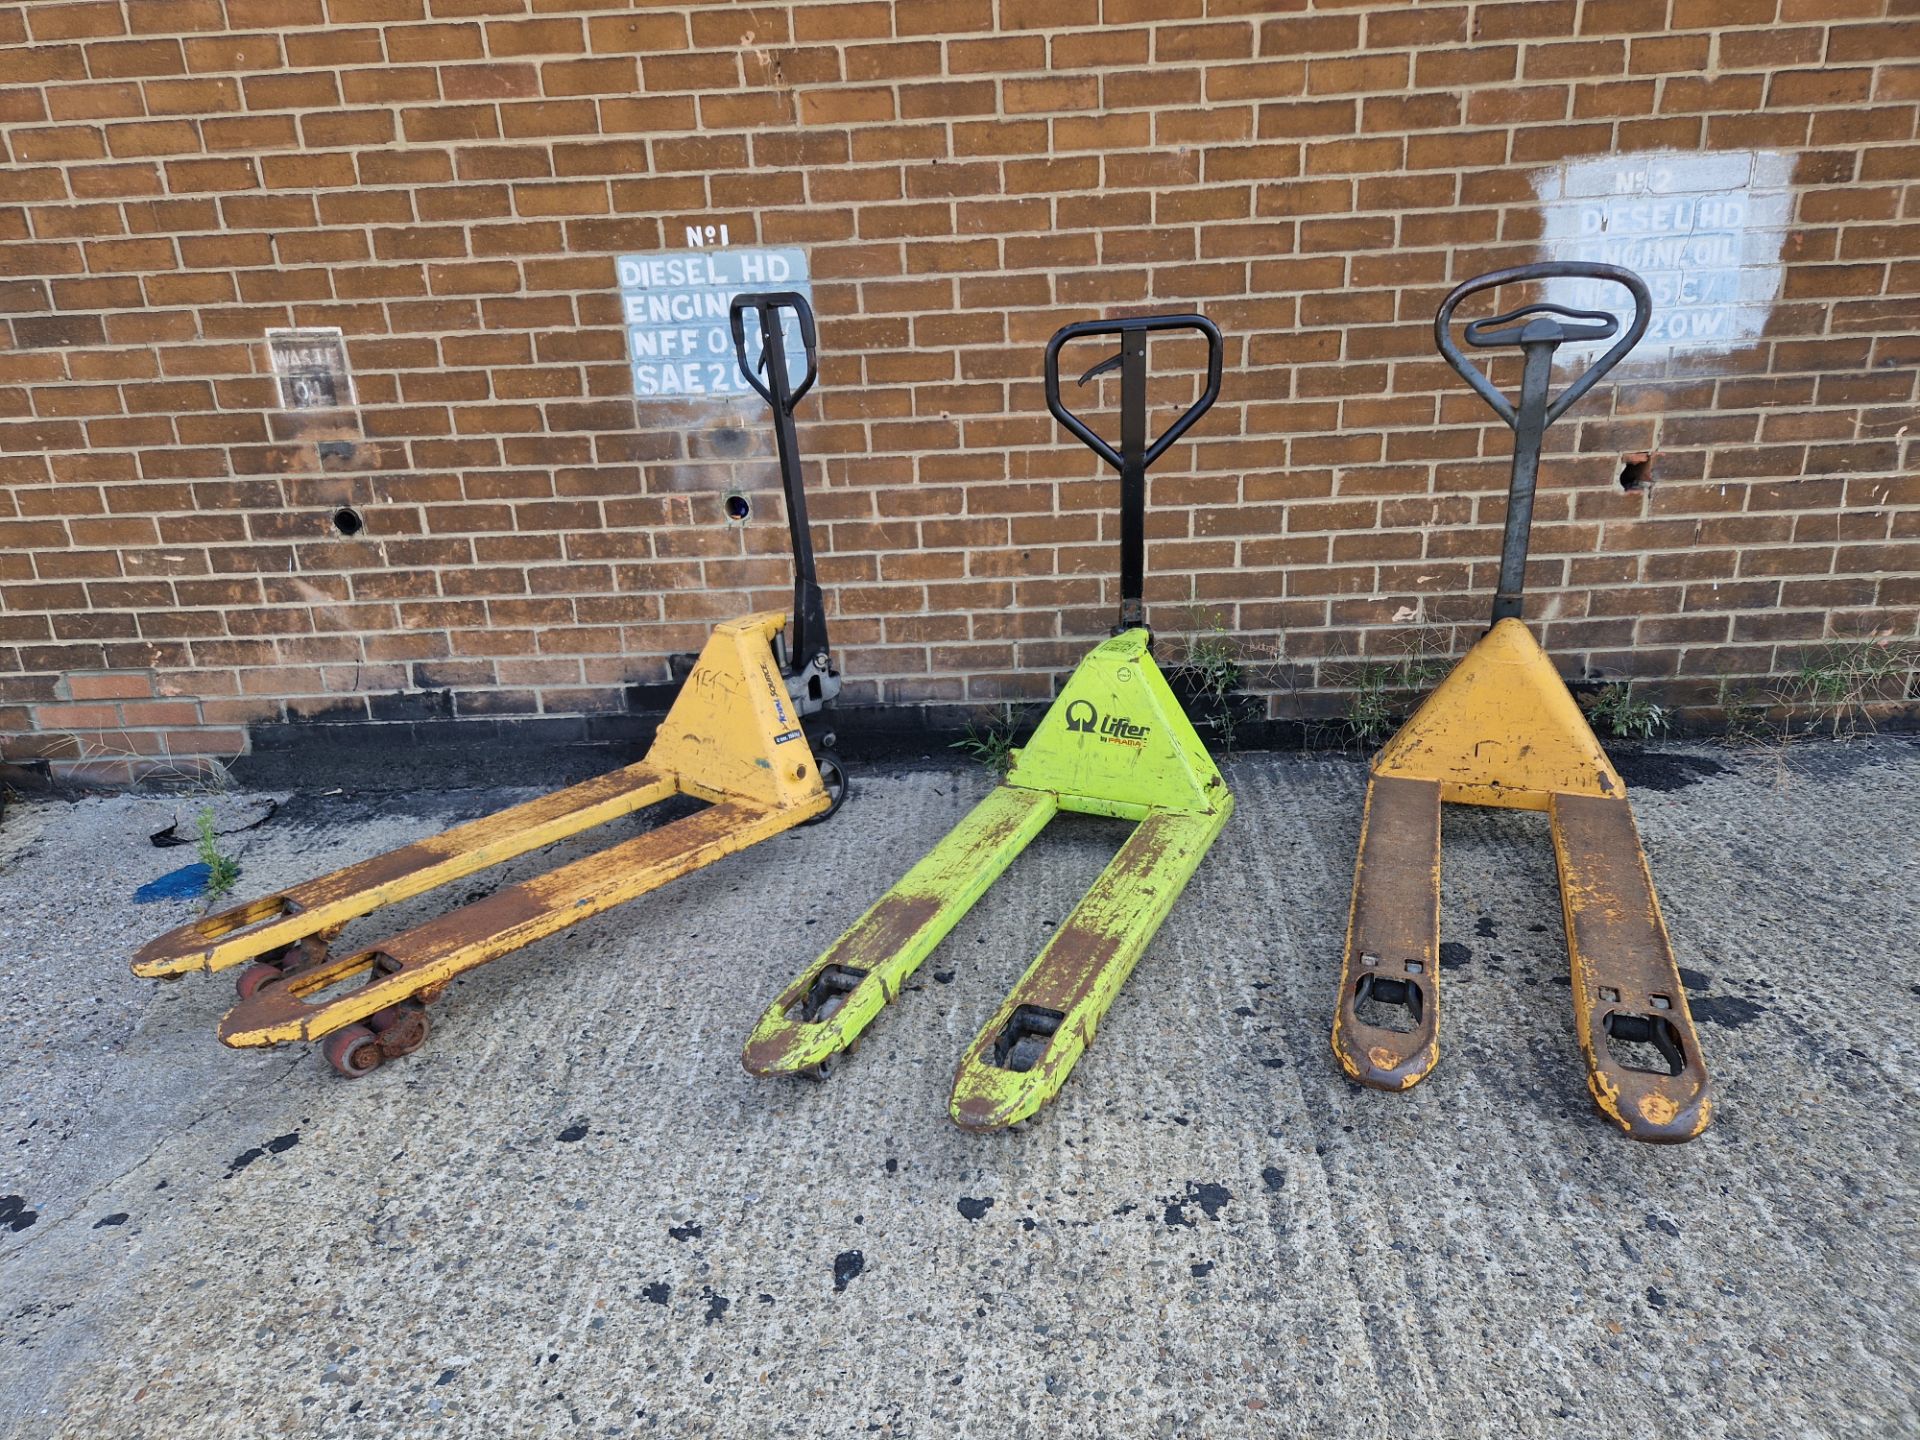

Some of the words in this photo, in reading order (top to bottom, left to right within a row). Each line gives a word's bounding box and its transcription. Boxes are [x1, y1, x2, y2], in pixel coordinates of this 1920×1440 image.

[1699, 202, 1745, 230] HD
[620, 256, 729, 288] DIESEL
[741, 254, 790, 283] HD
[633, 328, 700, 357] NFF
[637, 363, 705, 395] SAE
[1100, 714, 1151, 740] Lifter
